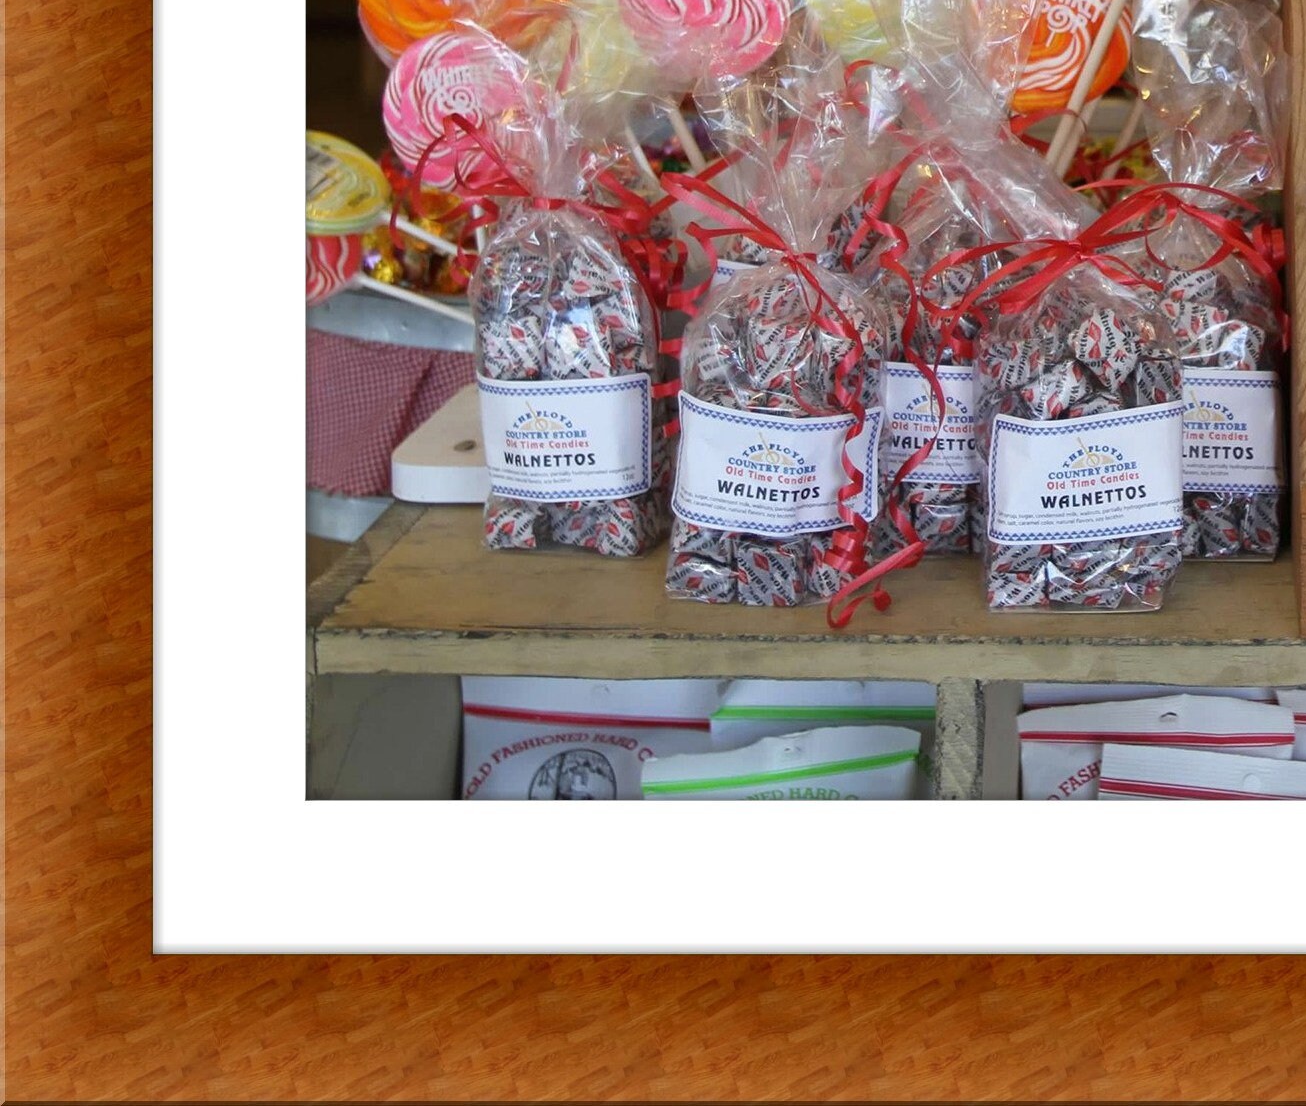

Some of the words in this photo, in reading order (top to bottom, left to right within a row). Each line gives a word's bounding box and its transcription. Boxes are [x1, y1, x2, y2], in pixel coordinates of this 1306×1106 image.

[906, 395, 928, 412] THE
[1200, 400, 1235, 421] FLOYD
[513, 411, 532, 429] THE
[536, 410, 573, 429] FLOYD
[891, 421, 909, 431] Old
[1213, 422, 1248, 431] STORE
[505, 430, 550, 440] COUNTRY
[552, 429, 588, 439] STORE
[520, 439, 545, 450] Time
[548, 438, 590, 449] Candies
[1208, 431, 1249, 442] Candies
[503, 451, 597, 468] WALNETTOS
[742, 443, 765, 458] THE
[769, 443, 805, 465] FLOYD
[1062, 448, 1085, 469] THE
[1088, 445, 1124, 461] FLOYD
[725, 465, 744, 477] Old
[749, 470, 773, 483] Time
[777, 474, 817, 485] Candies
[728, 456, 780, 473] COUNTRY
[783, 464, 817, 475] STORE
[1047, 466, 1101, 481] COUNTRY
[1104, 460, 1138, 474] STORE
[1046, 480, 1066, 491] Old
[1071, 477, 1097, 489] Time
[1100, 470, 1141, 484] Candies
[717, 479, 821, 503] WALNETTOS
[1041, 484, 1148, 510] WALNETTOS
[491, 732, 589, 765] FASHIONED
[1059, 759, 1102, 795] FASH
